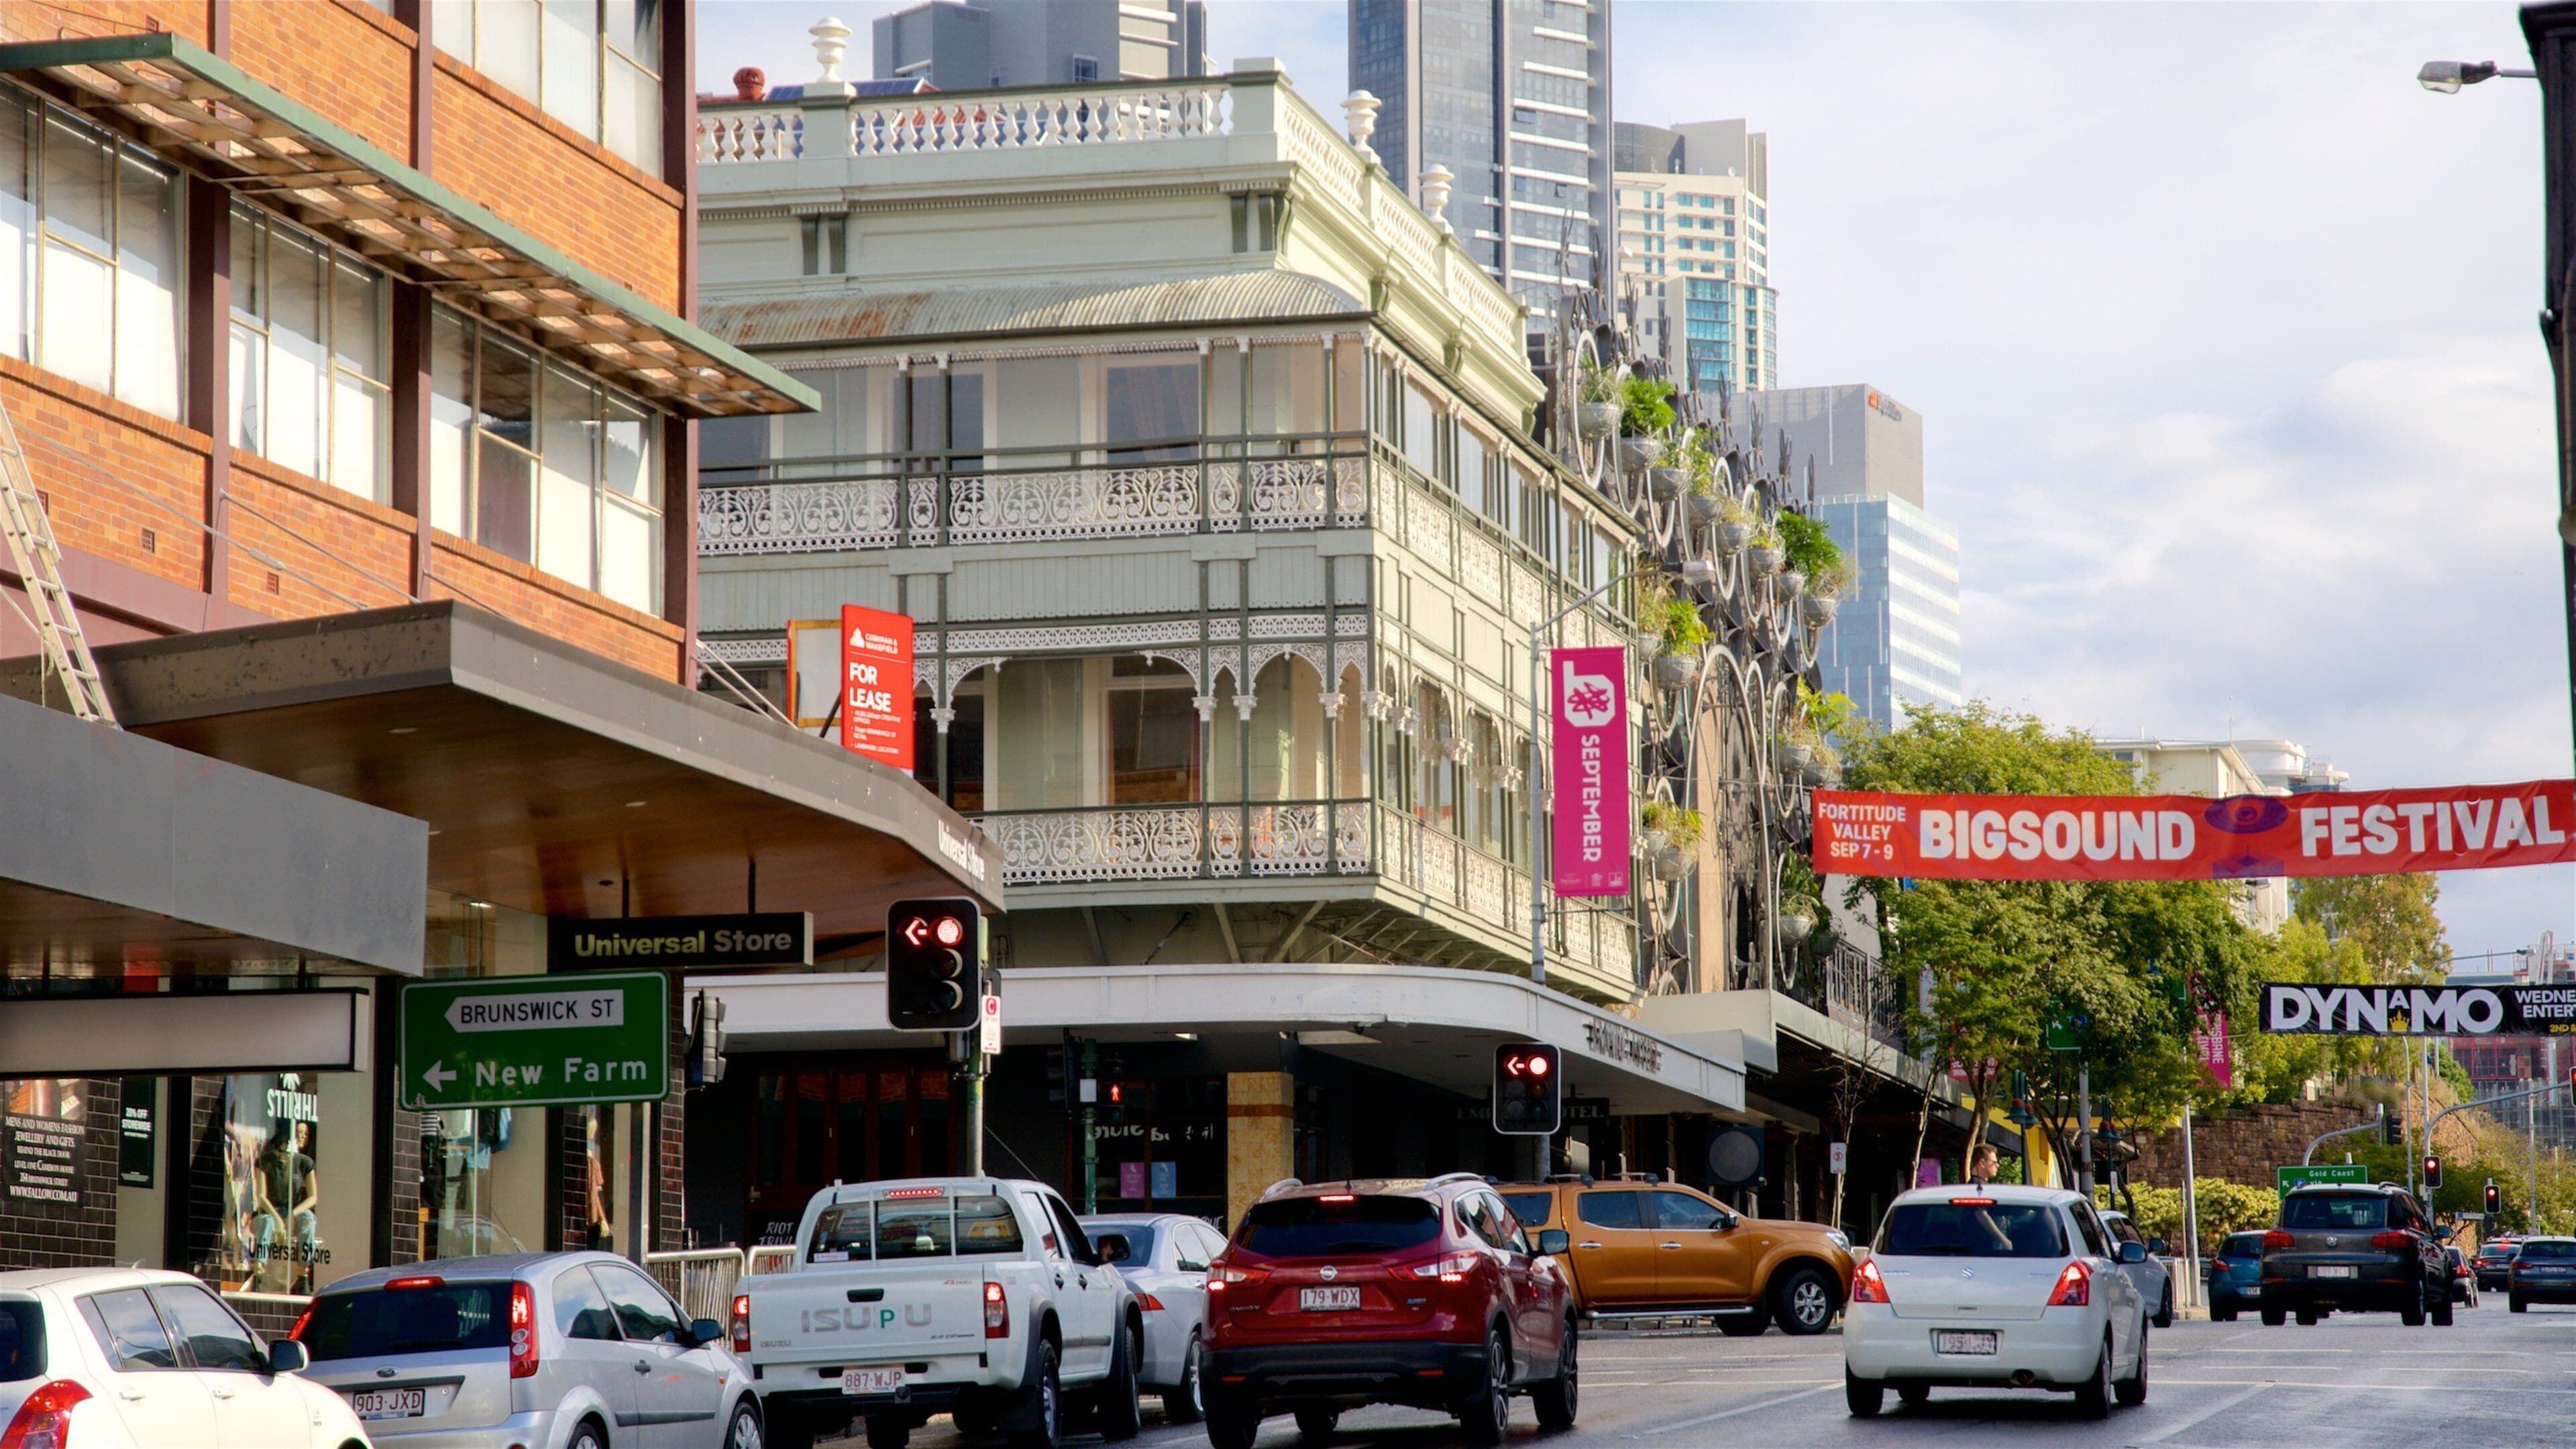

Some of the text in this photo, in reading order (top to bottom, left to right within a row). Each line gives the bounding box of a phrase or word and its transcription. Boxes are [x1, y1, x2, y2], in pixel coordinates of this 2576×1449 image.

[849, 662, 877, 686] FOR
[849, 686, 892, 712] LEASE
[1582, 734, 1602, 862] SEPTEMBER
[1818, 803, 1906, 822] FORTITUDE
[1833, 822, 1891, 841] VALLEY
[1919, 795, 2565, 861] BIGSOUND FESTIVAL
[1830, 841, 1860, 858] SEP
[1862, 843, 1872, 858] 7
[1883, 843, 1894, 860] 9
[575, 928, 792, 957] Universal Store
[461, 999, 614, 1024] BRUNSWICK ST
[2270, 986, 2504, 1034] DYNAMO
[476, 1057, 647, 1087] New Farm
[5, 1116, 21, 1128] MENS
[22, 1118, 36, 1130] AND
[61, 1122, 85, 1135] FASHION
[14, 1130, 45, 1144] JEWELLERY
[46, 1134, 58, 1146] AND
[2331, 1169, 2355, 1177] Coast
[765, 1222, 794, 1235] RIOT
[248, 1237, 331, 1265] Universal Store
